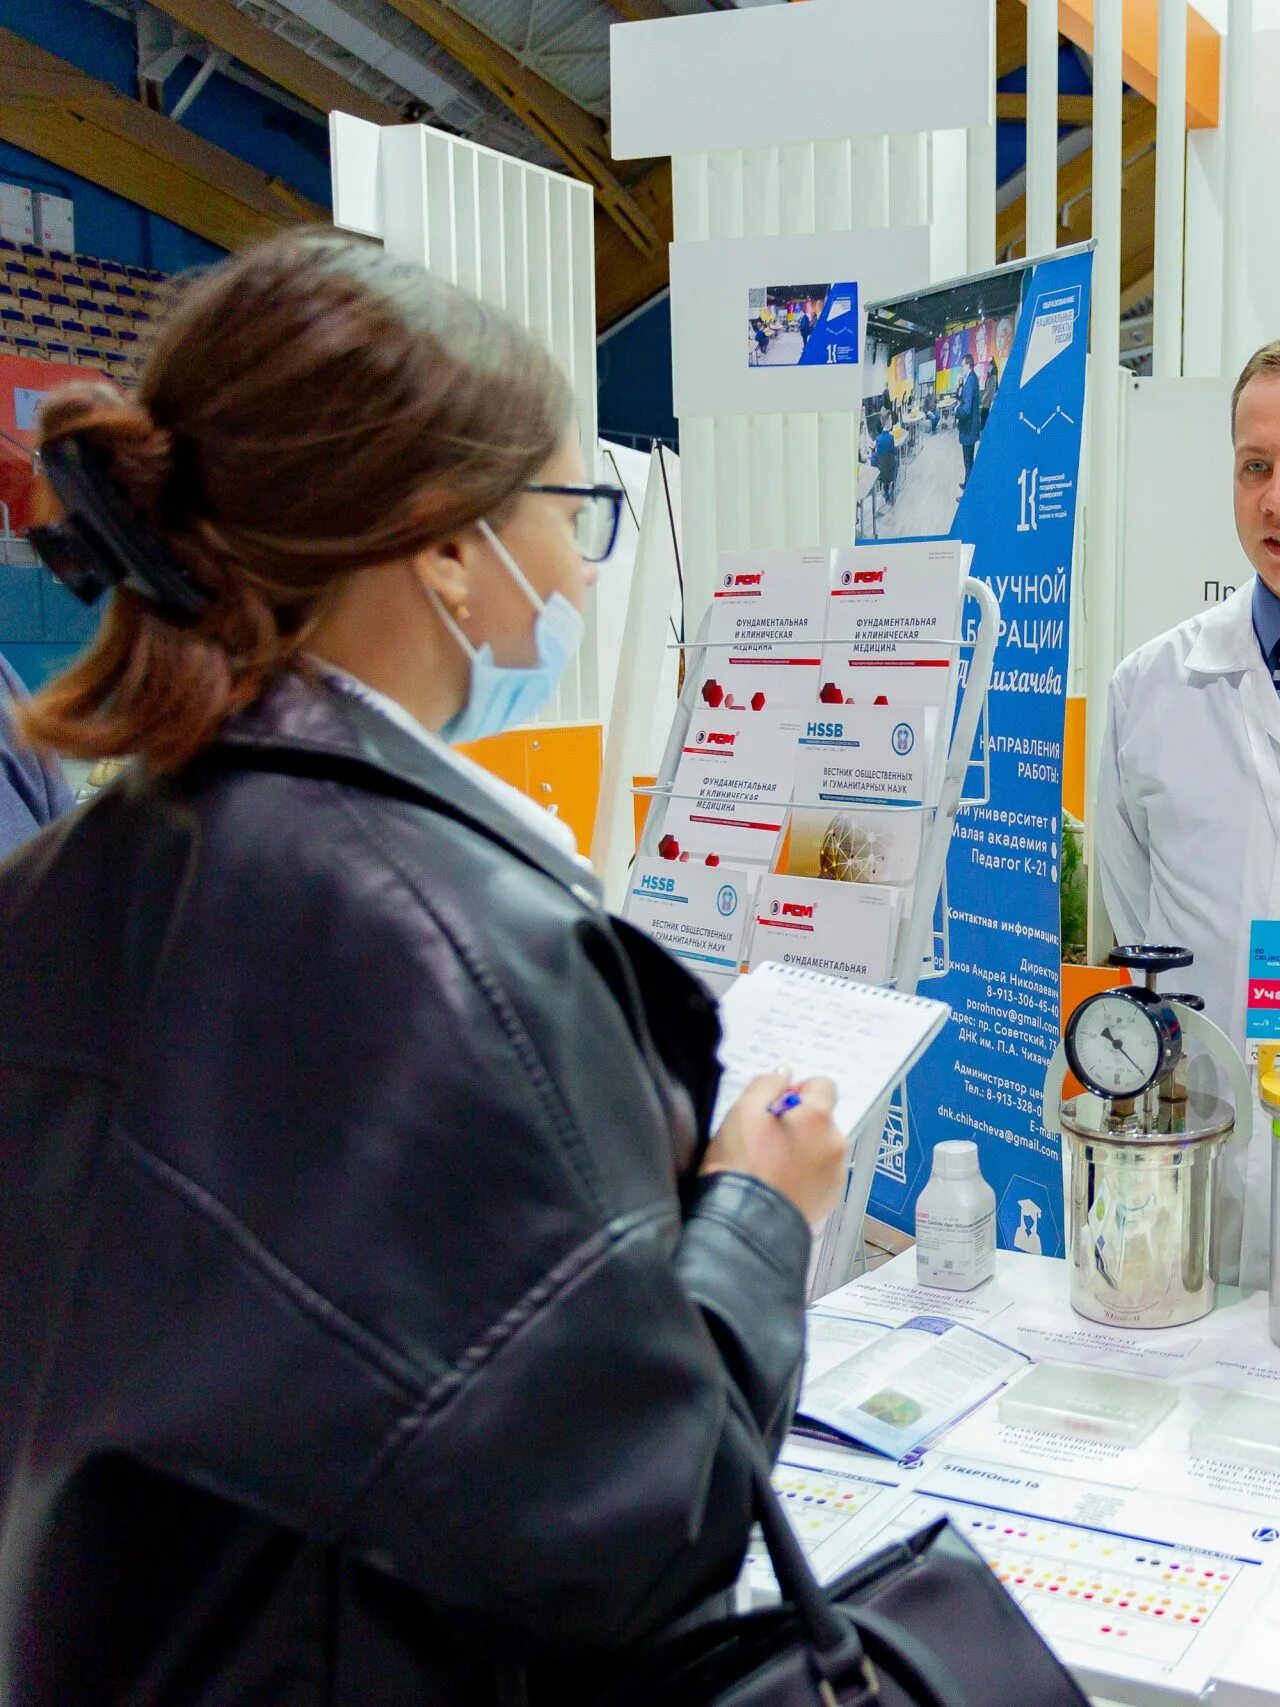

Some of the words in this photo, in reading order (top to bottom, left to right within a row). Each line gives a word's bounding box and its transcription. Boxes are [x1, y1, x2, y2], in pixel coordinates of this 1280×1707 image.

[736, 618, 808, 627] ФУНДАМЕНТАЛЬНАЯ
[856, 617, 937, 627] ФУНДАМЕНТАЛЬНАЯ
[741, 630, 793, 639] КЛИНИЧЕСКАЯ
[855, 631, 860, 639] И
[861, 630, 919, 639] КЛИНИЧЕСКАЯ
[853, 643, 897, 653] МЕДИЦИНА
[807, 722, 843, 738] HSSB
[823, 767, 853, 779] ВЕСТНИК
[855, 769, 913, 782] ОБЩЕСТВЕННЫХ
[1018, 762, 1060, 784] РАБОТЫ:
[702, 777, 777, 793] ФУНДАМЕНТАЛЬНАЯ
[823, 780, 829, 788] И
[830, 780, 886, 793] ГУМАНИТАРНЫХ
[887, 784, 908, 794] НАУК
[696, 800, 736, 813] МЕДИЦИНА
[973, 808, 1049, 828] университет
[987, 833, 1048, 853] академия
[971, 848, 1021, 870] Педагог
[1024, 857, 1048, 877] К-21
[640, 874, 675, 893] HSSB
[652, 919, 680, 932] ВЕСТНИК
[680, 923, 733, 942] ОБЩЕСТВЕННЫХ
[1001, 921, 1059, 946] информация:
[655, 932, 706, 949] ГУМАНИТАРНЫХ
[707, 941, 726, 953] НАУК
[783, 953, 867, 975] ФУНДАМЕНТАЛЬНАЯ
[1020, 958, 1059, 984] Директор
[972, 964, 1006, 984] Андрей
[1009, 975, 1059, 1000] Николаевич
[986, 985, 1059, 1018] 8-913-306-45-40
[966, 998, 1059, 1036] porohnov@gmail.com
[958, 1027, 977, 1044] ДНК
[979, 1037, 995, 1050] им.
[997, 1040, 1019, 1057] П.А.
[978, 1021, 991, 1032] пр.
[994, 1021, 1048, 1049] Советский,
[954, 1060, 1027, 1094] Администратор
[964, 1079, 985, 1097] Тел.:
[937, 1103, 1059, 1161] dnk.chihacheva@gmail.com
[1029, 1119, 1059, 1144] E-mail:
